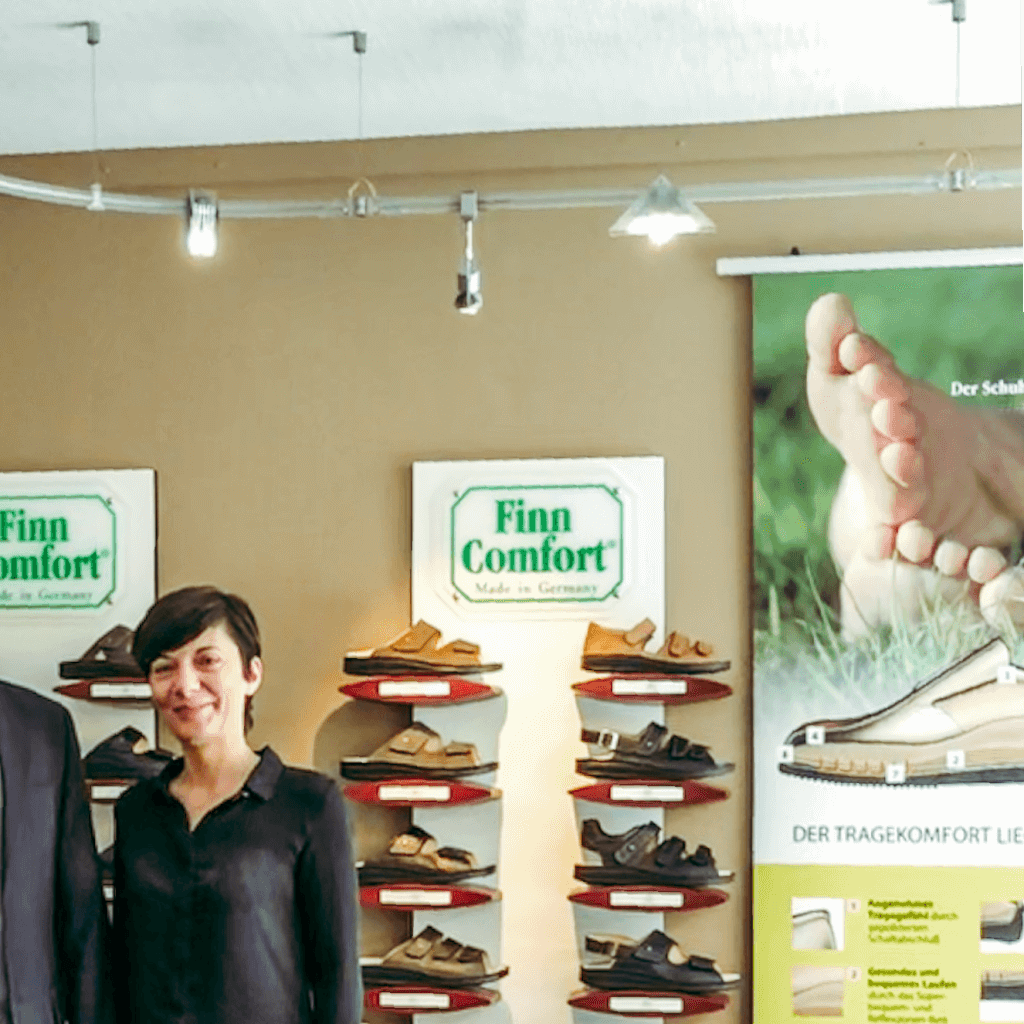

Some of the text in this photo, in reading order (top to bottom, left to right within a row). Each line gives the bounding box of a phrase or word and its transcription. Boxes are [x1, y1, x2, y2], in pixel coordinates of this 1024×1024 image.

[951, 380, 979, 397] Der
[494, 498, 573, 534] Finn
[461, 534, 607, 574] Comfort
[475, 580, 599, 597] Made in Germany
[792, 824, 1024, 845] DER TRAGEKOMFORT LIE
